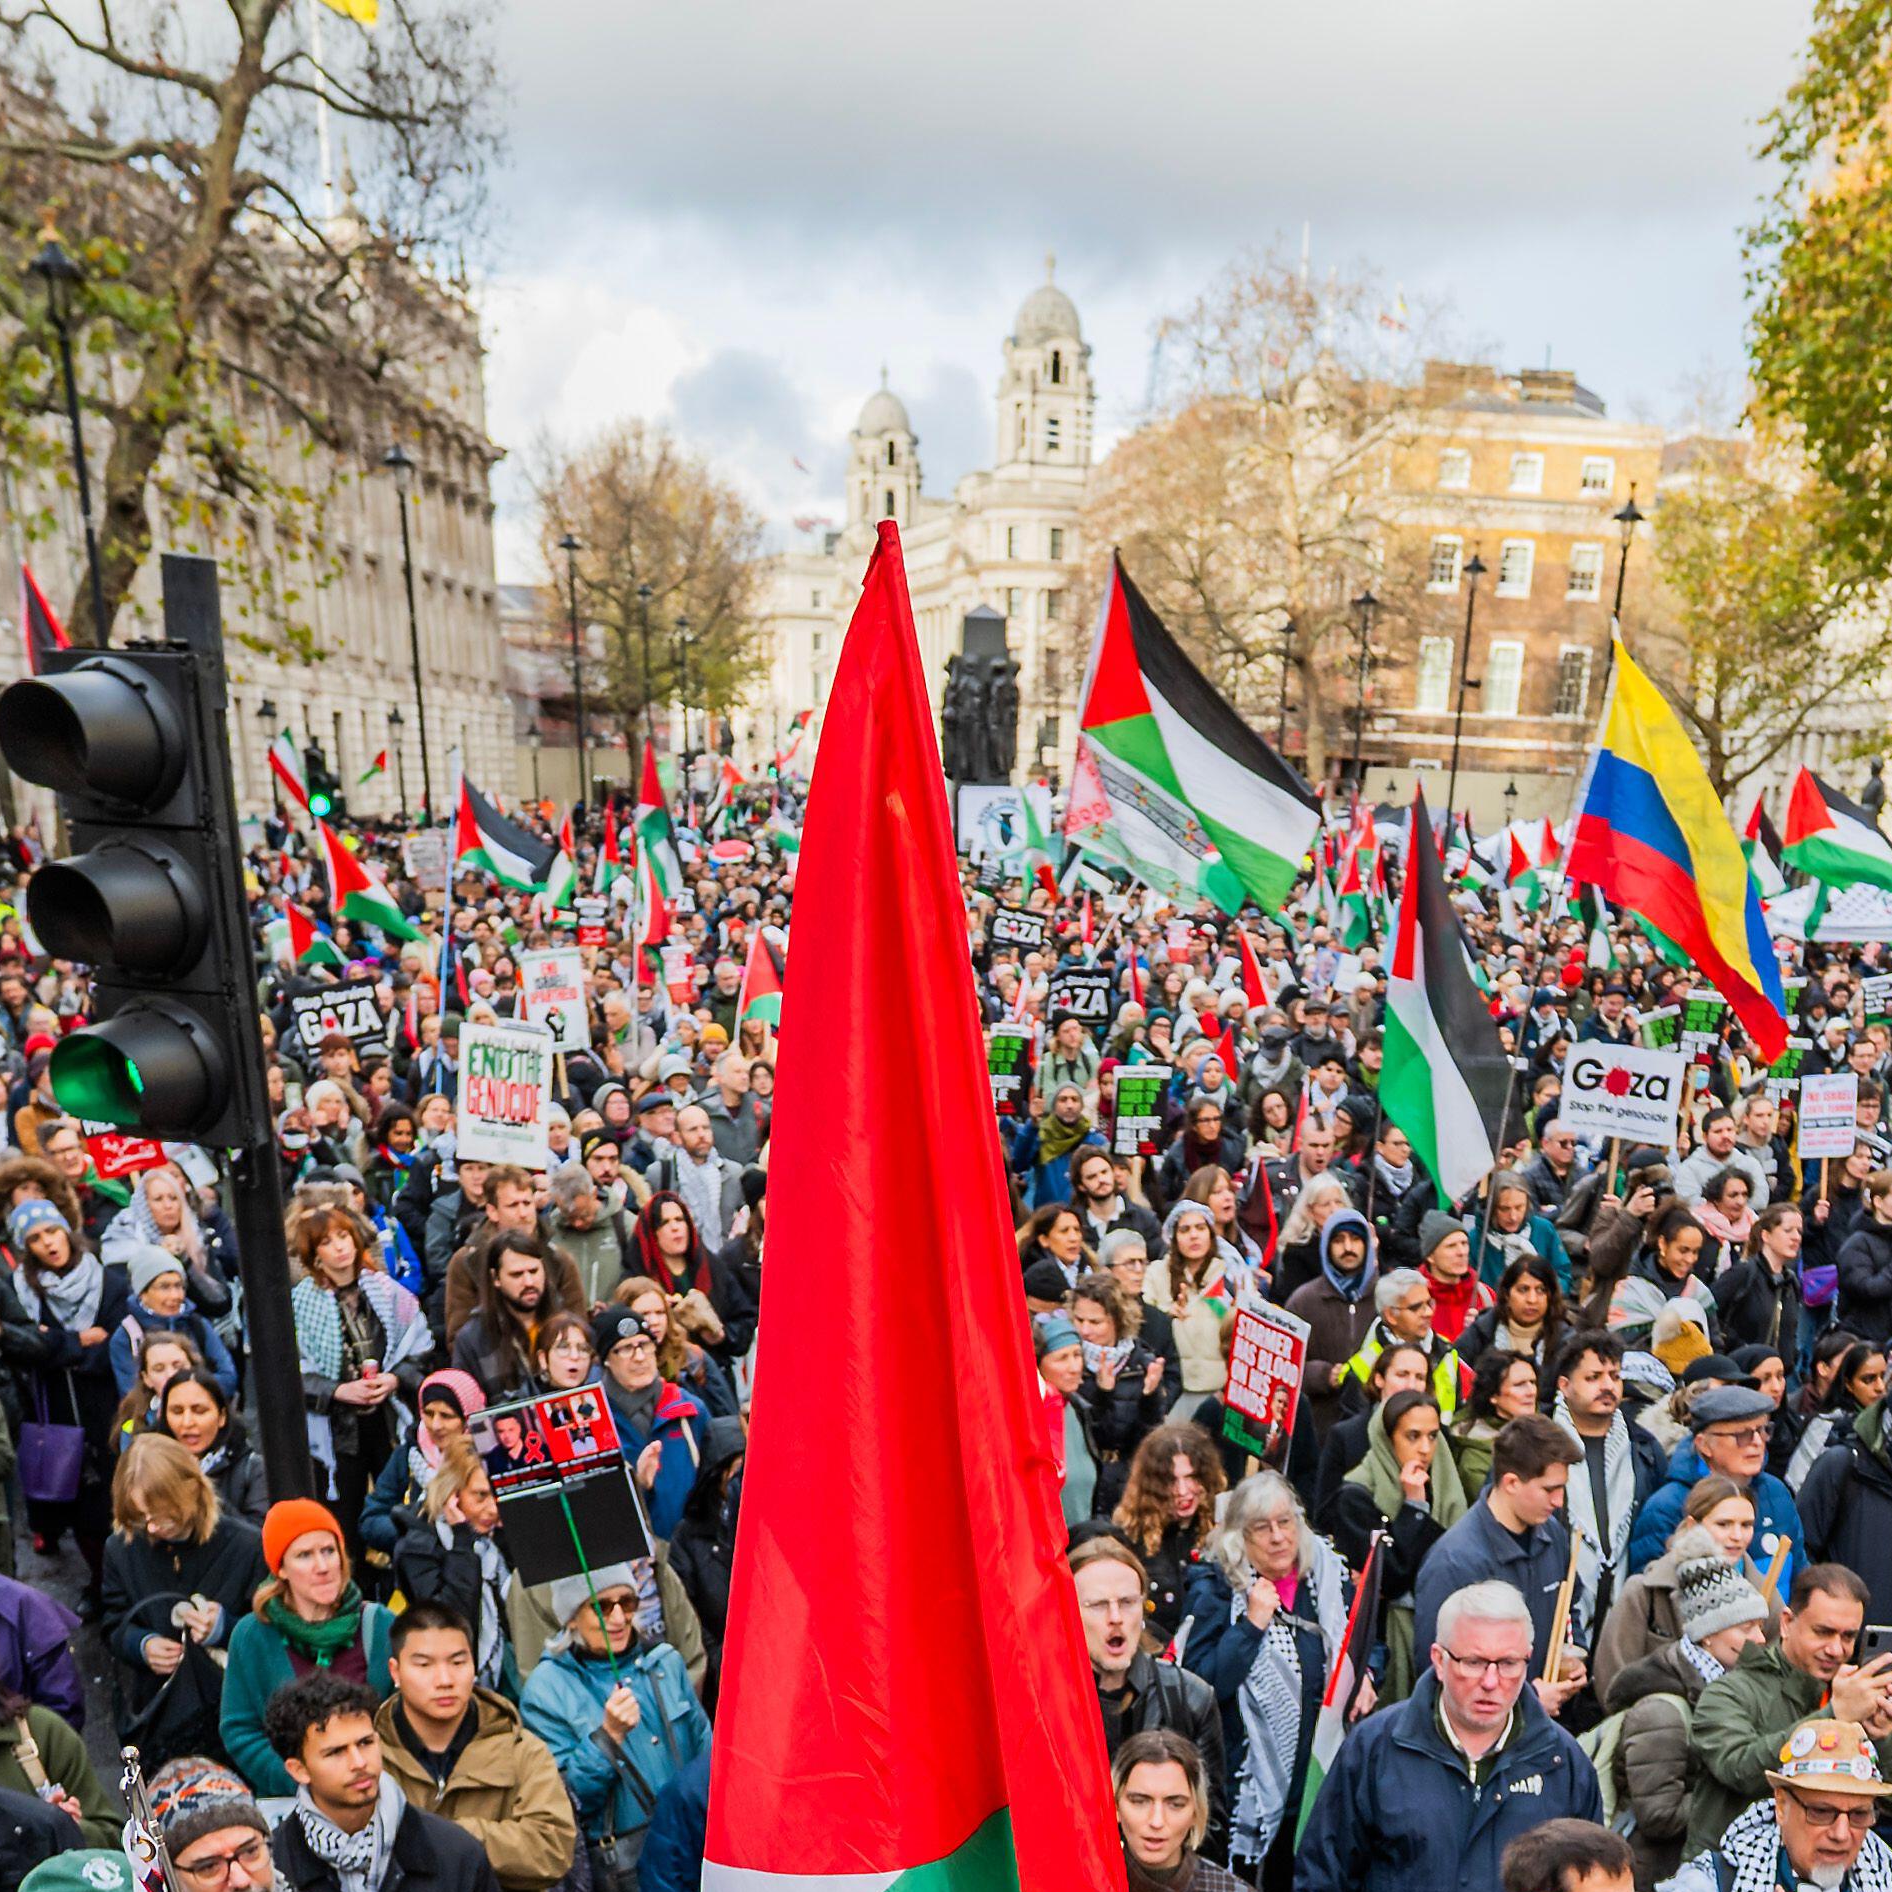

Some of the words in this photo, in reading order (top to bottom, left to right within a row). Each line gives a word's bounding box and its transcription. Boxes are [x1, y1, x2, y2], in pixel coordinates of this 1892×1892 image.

[298, 998, 385, 1046] GAZA
[467, 1075, 541, 1124] GENOCIDE
[1572, 1058, 1671, 1102] Gza
[1570, 1100, 1594, 1114] Stop
[1597, 1102, 1616, 1116] the
[1618, 1105, 1669, 1124] genocide
[1237, 1313, 1294, 1360] STARMER
[1257, 1348, 1300, 1388] BLOOD
